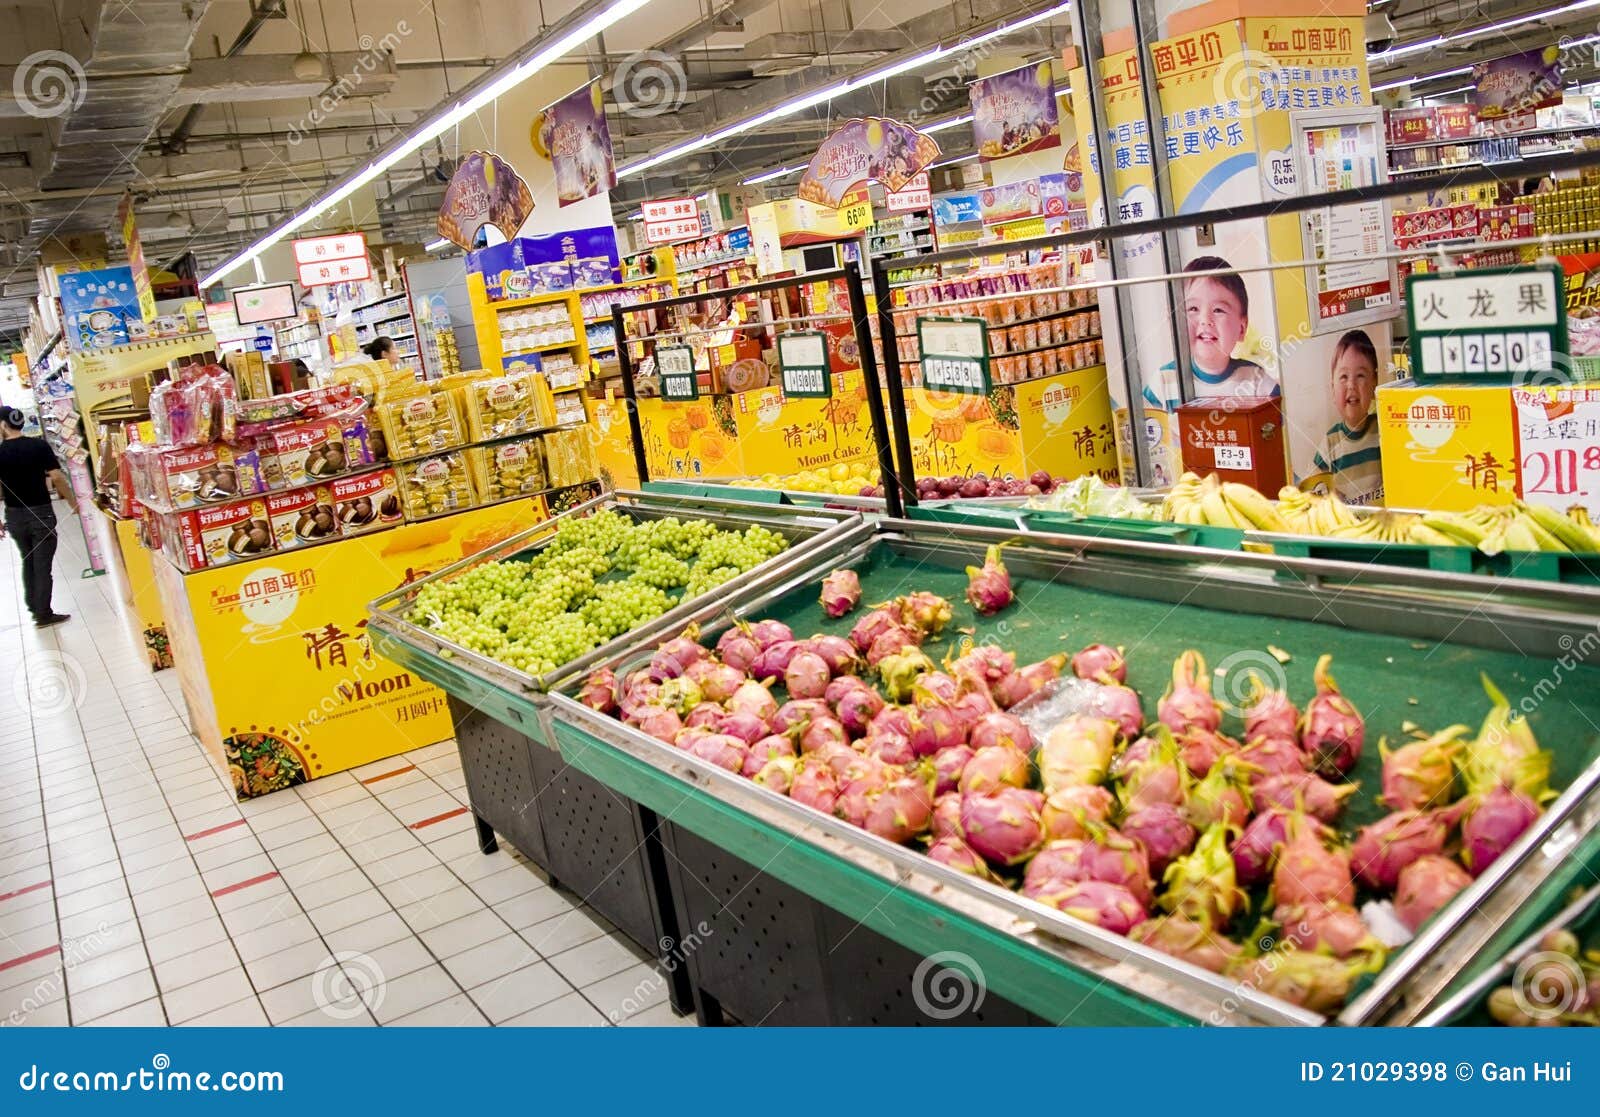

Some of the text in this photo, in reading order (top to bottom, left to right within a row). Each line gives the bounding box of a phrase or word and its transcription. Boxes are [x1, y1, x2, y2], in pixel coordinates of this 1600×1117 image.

[1292, 27, 1352, 51] 中商平价
[1261, 85, 1363, 111] 健康宝宝更快乐
[314, 242, 346, 256] 奶粉
[318, 264, 350, 278] 奶粉
[1422, 282, 1547, 322] 火龙果
[1411, 404, 1472, 421] 中商平价
[797, 446, 862, 468] Moon Cake
[1221, 448, 1245, 459] F3-9
[244, 568, 317, 599] 中商平价
[338, 672, 412, 706] Moon
